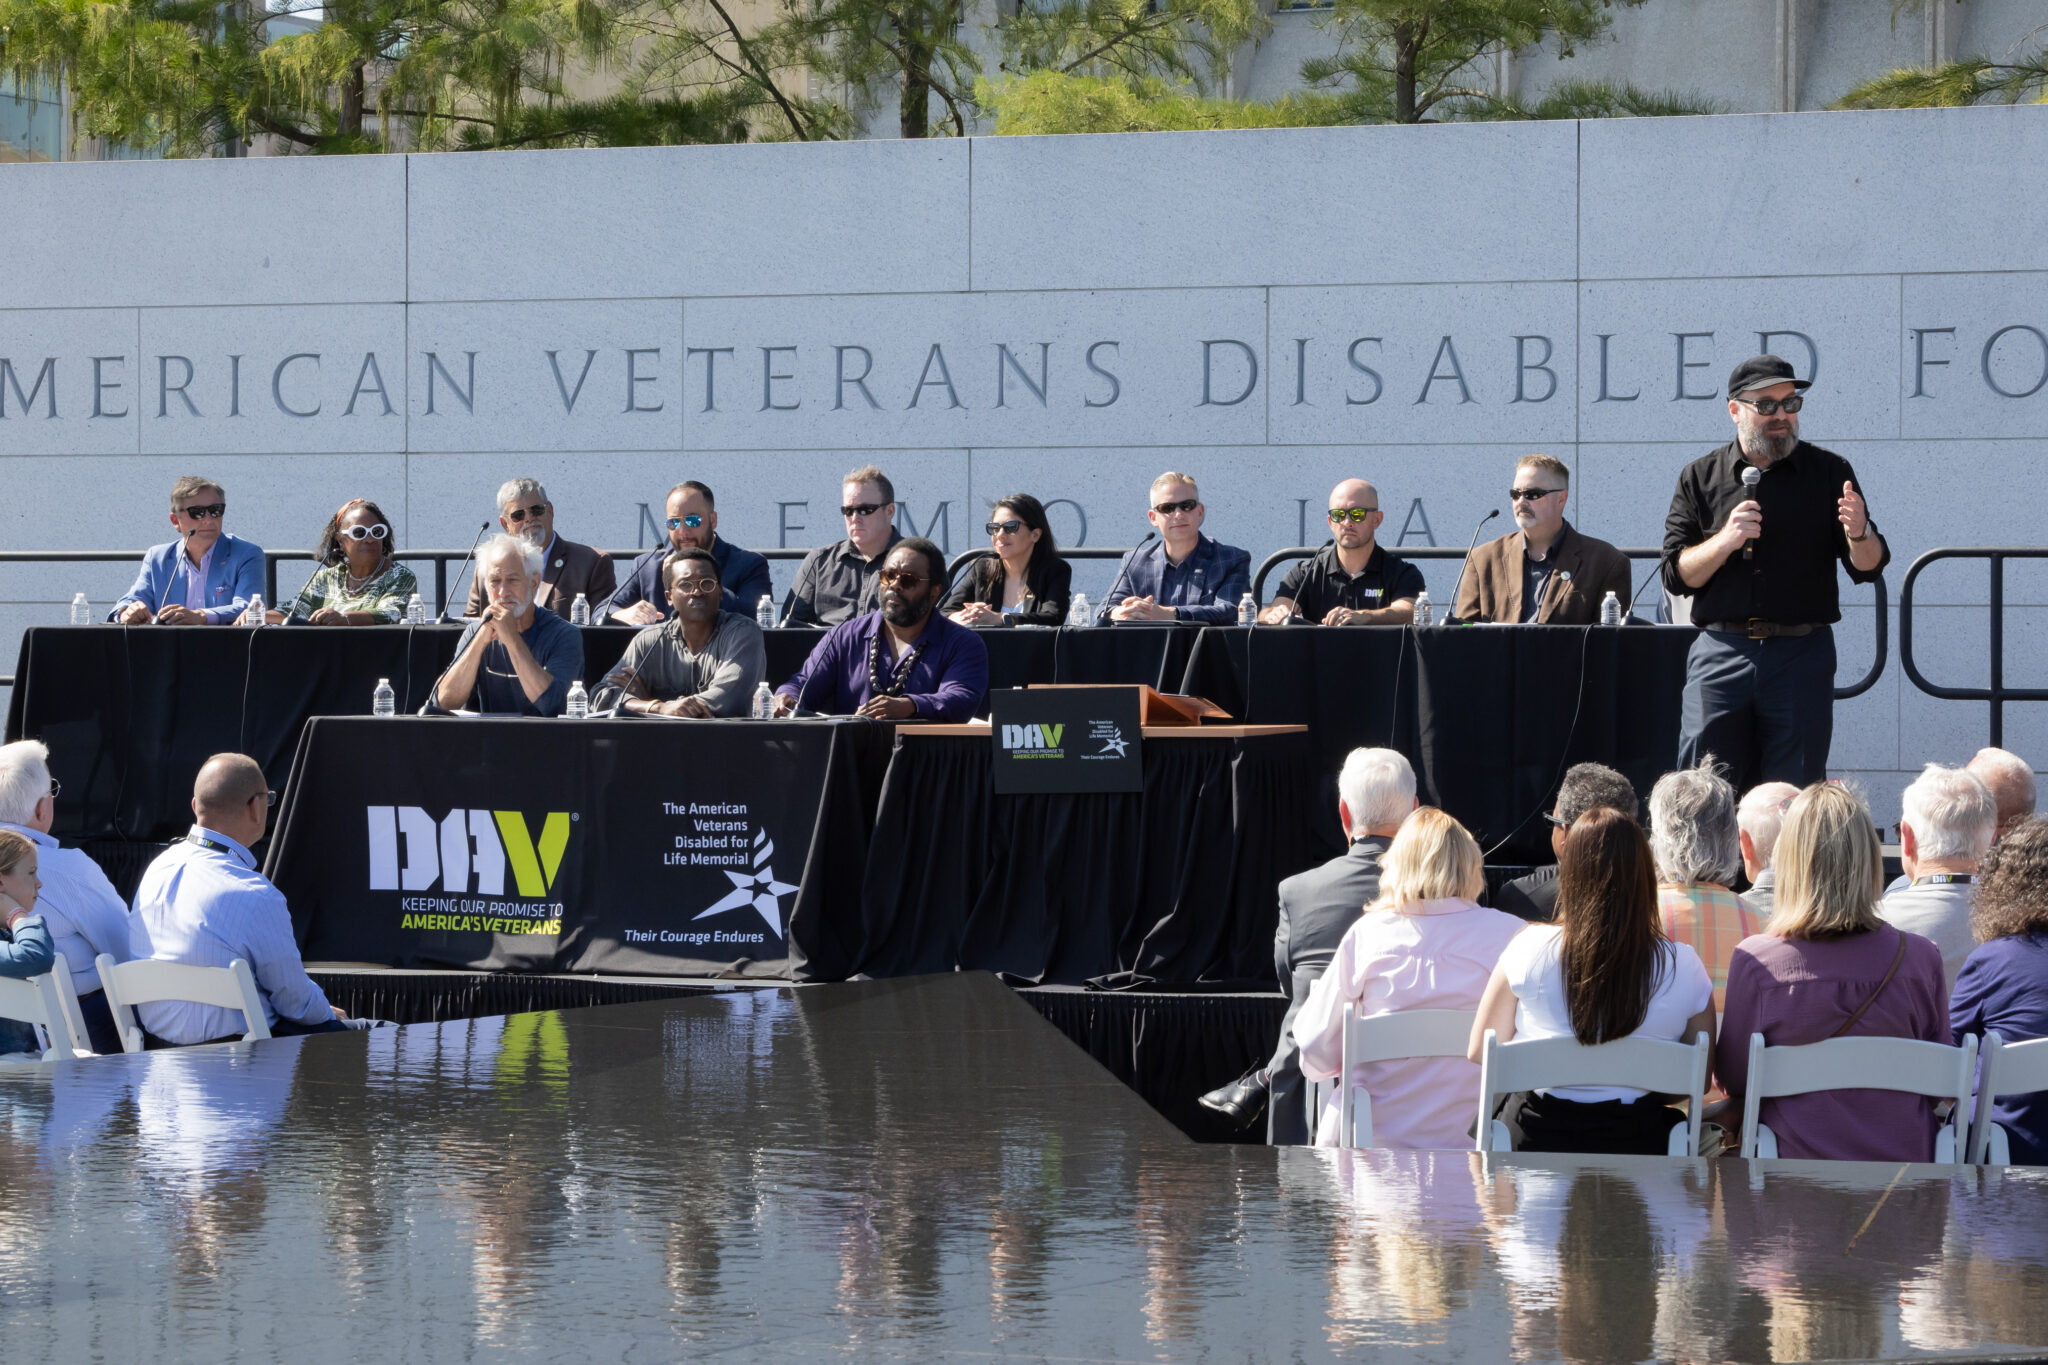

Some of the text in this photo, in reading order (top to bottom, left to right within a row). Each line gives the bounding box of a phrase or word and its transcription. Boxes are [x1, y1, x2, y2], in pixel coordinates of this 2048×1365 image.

[545, 341, 1121, 415] VETERANS
[1194, 330, 1818, 408] DISABLED
[1364, 589, 1384, 597] DAV
[1002, 724, 1063, 749] DAV
[663, 802, 747, 815] The American
[694, 819, 748, 832] Veterans
[675, 835, 749, 848] Disabled for
[663, 852, 749, 865] Life Memorial
[1932, 875, 1953, 883] DAV
[402, 897, 564, 917] KEEPING OUR PROMISE TO
[401, 914, 562, 935] AMERICA'S VETERANS
[624, 929, 764, 945] Their Courage Endures
